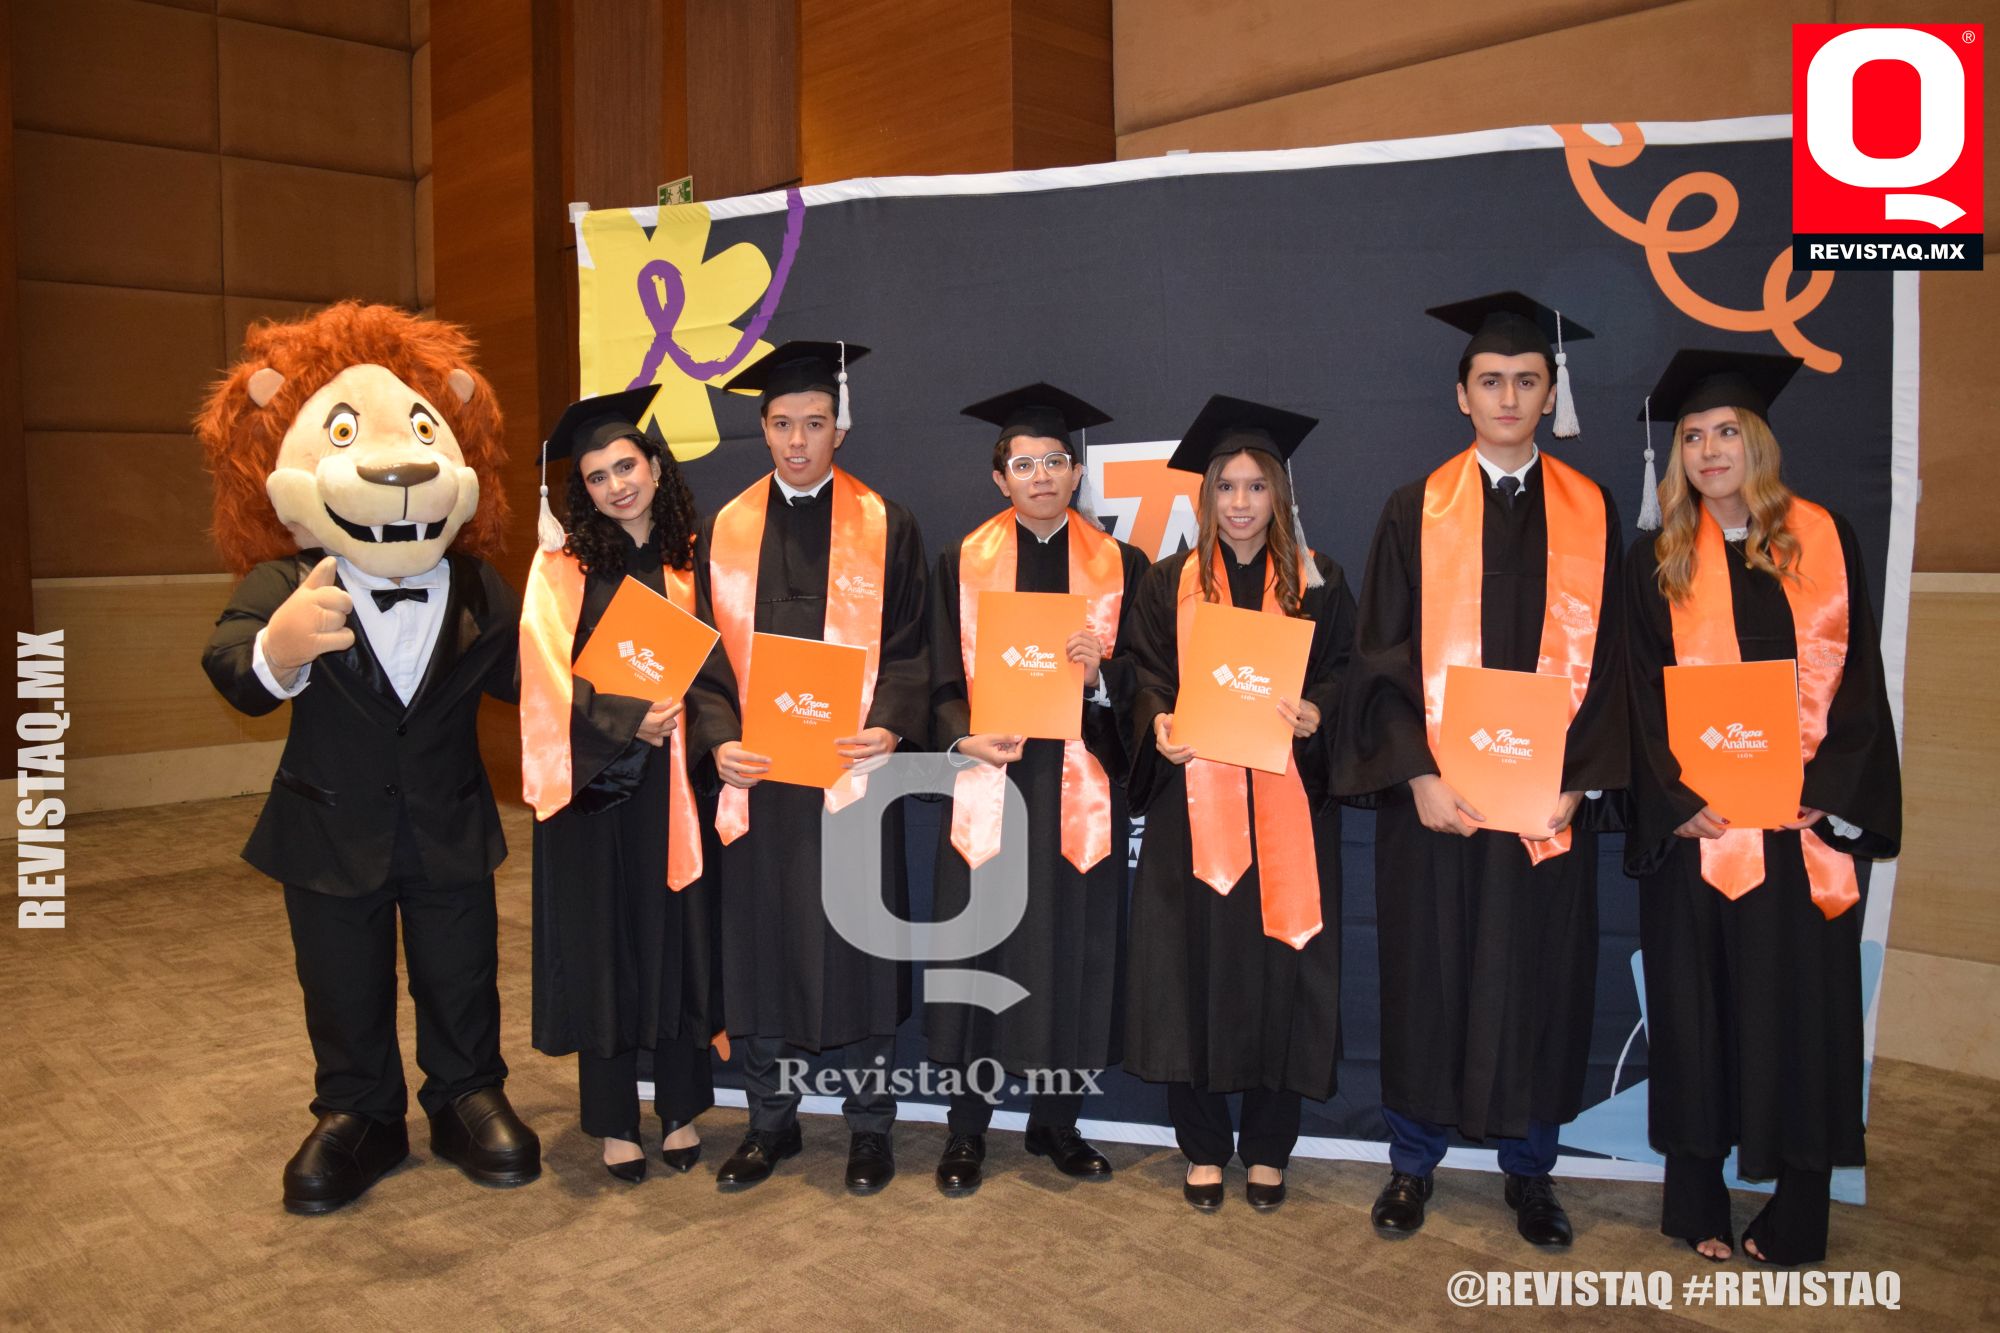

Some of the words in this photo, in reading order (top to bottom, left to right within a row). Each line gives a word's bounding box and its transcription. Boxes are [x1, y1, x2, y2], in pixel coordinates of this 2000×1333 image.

[1024, 645, 1056, 659] Prepa
[1237, 666, 1271, 683] Prepa
[798, 693, 829, 709] Prepa
[1496, 728, 1531, 745] Prepa
[1727, 722, 1764, 739] Prepa
[1722, 738, 1769, 750] Anáhuac
